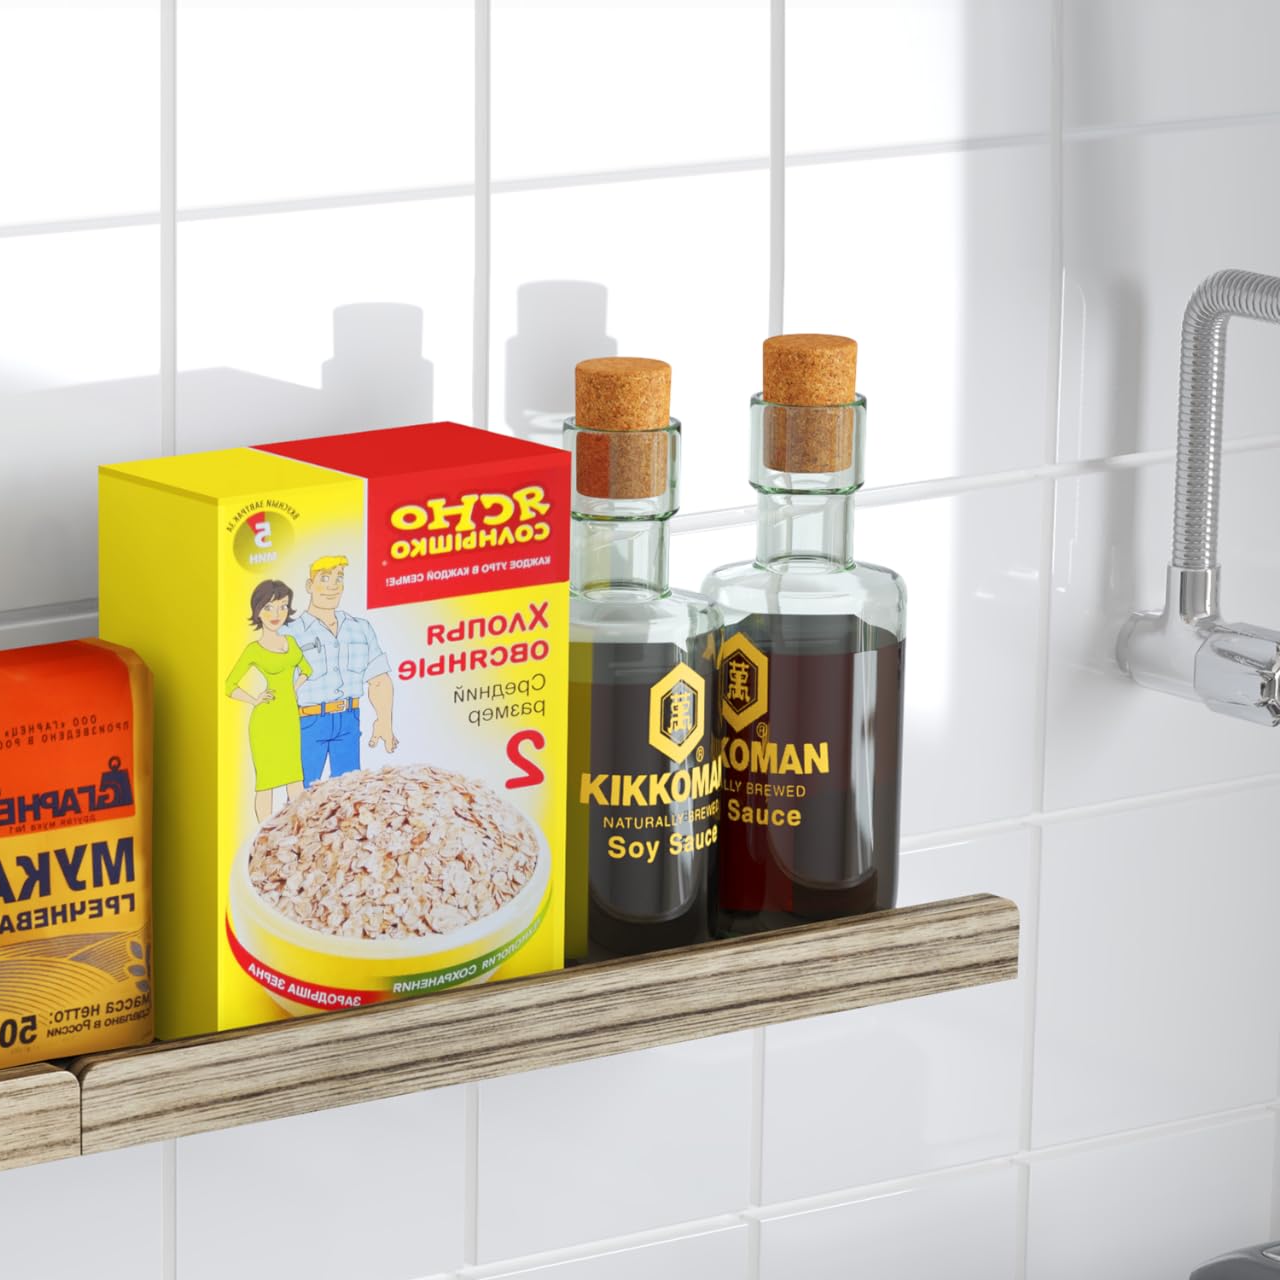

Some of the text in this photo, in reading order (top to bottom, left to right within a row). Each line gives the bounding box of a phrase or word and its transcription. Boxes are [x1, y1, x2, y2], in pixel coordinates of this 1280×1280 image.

[746, 781, 806, 798] BREWED
[603, 813, 684, 829] NATURALLY
[727, 799, 802, 827] Sauce
[607, 824, 718, 864] Soy Sauce
